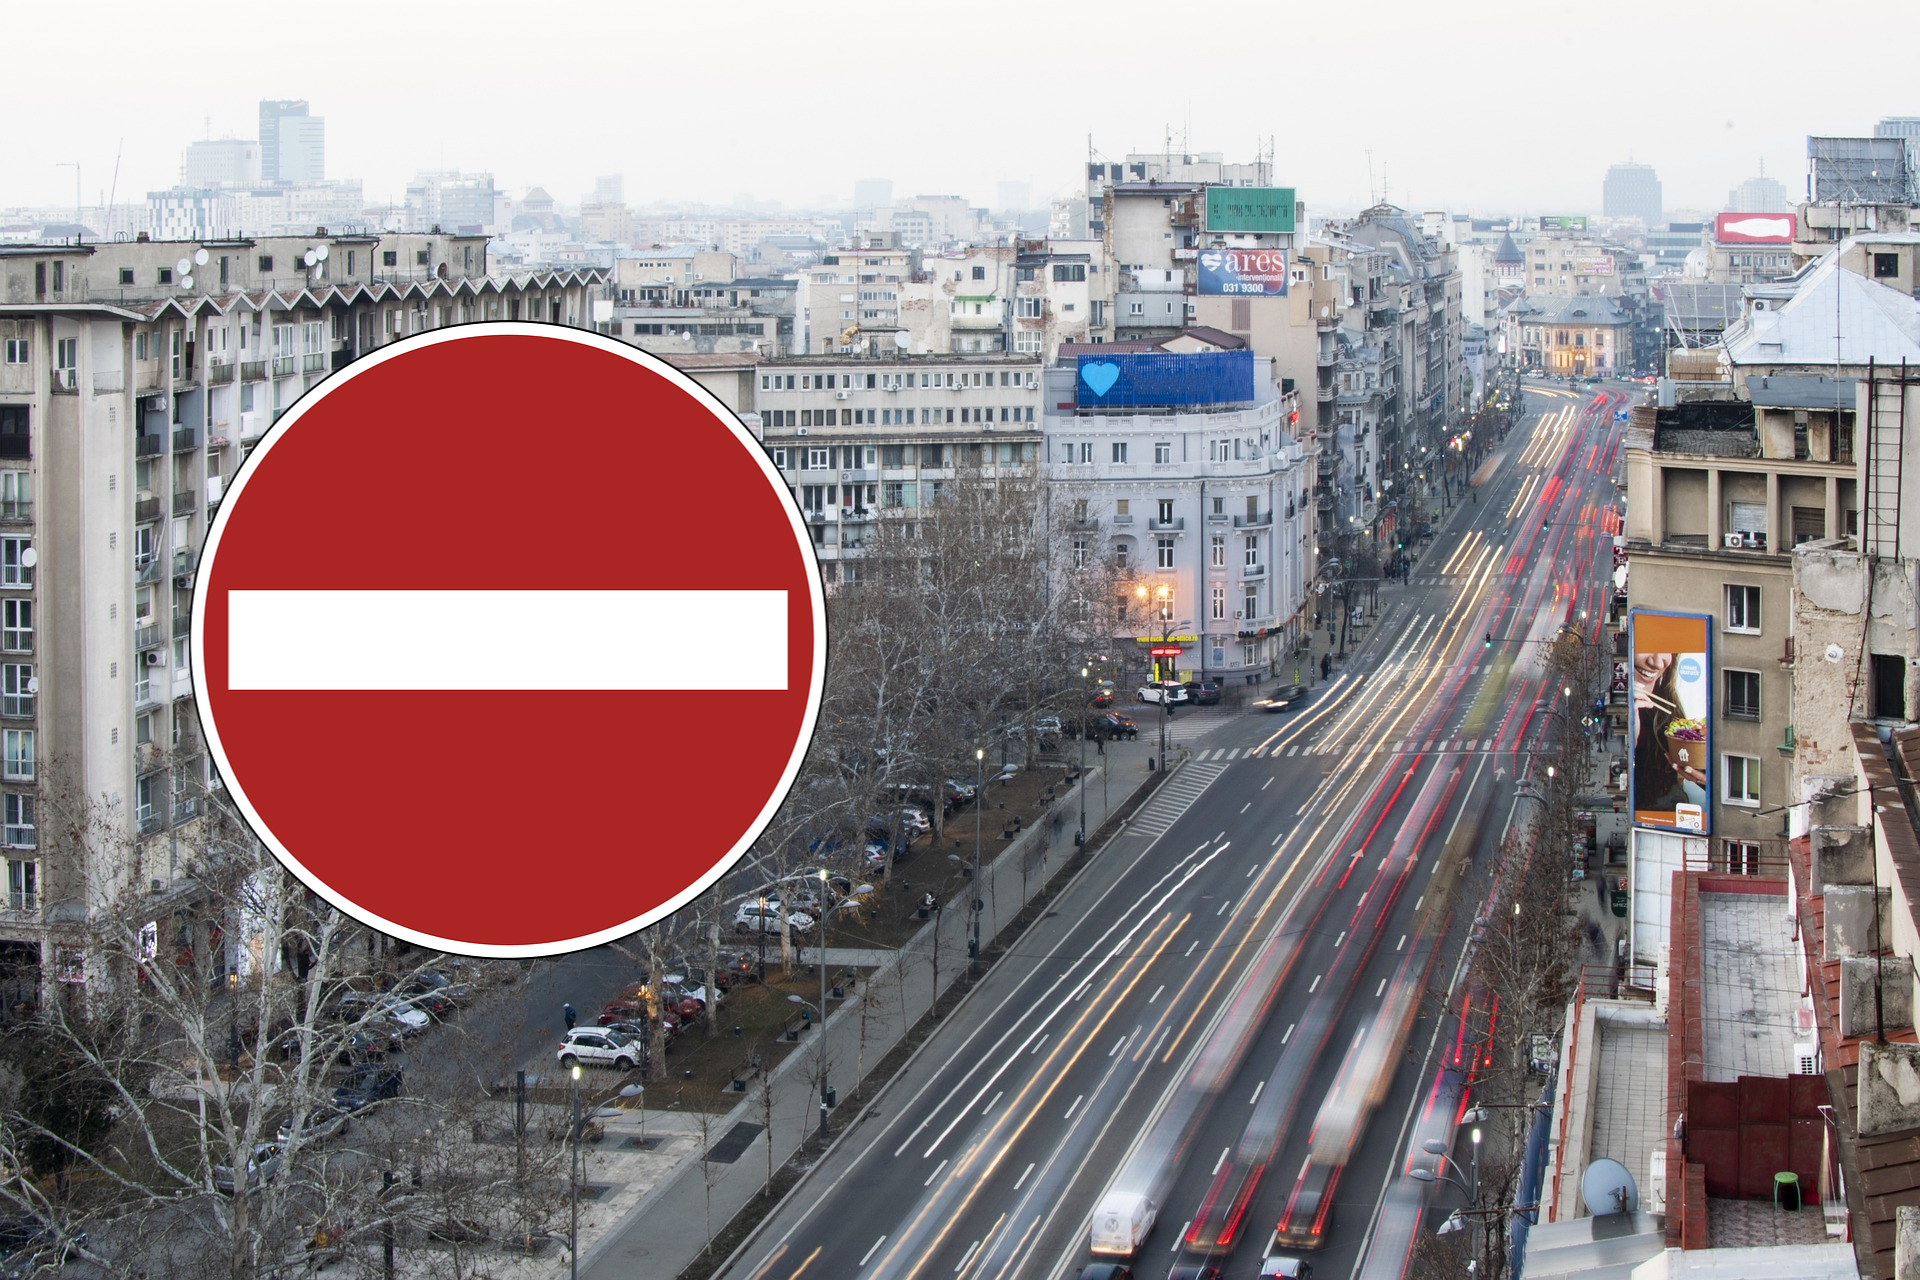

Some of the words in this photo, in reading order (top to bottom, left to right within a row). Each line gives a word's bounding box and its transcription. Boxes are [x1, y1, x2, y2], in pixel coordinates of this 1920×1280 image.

[1224, 253, 1285, 273] ares
[1222, 283, 1239, 293] 031
[1241, 283, 1264, 293] 9300
[1238, 630, 1254, 639] DAL
